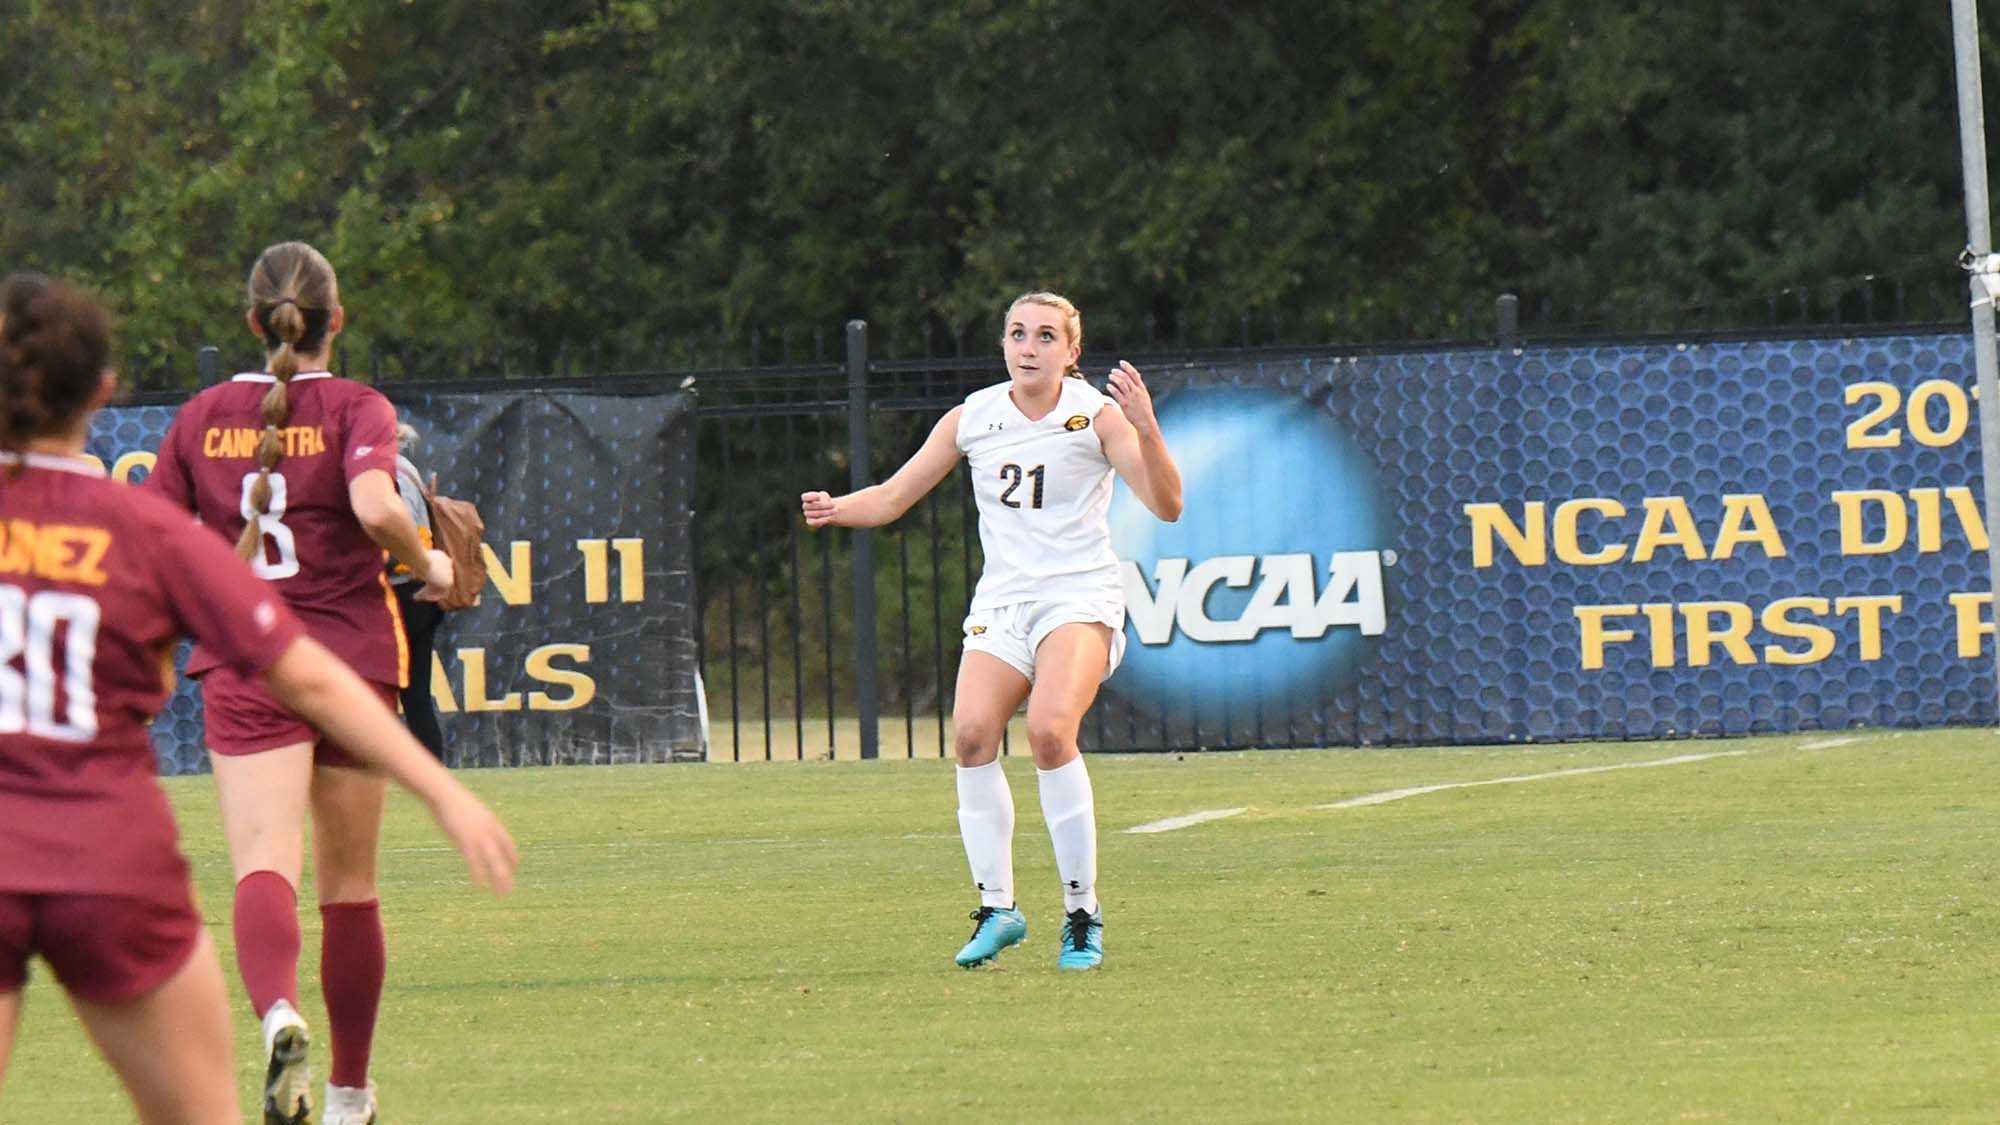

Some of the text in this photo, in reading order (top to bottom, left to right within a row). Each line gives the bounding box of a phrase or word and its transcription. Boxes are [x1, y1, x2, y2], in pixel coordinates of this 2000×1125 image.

[1844, 379, 1980, 449] 20
[1000, 464, 1045, 509] 21
[240, 472, 300, 580] 8
[1464, 494, 1786, 568] NCAA
[1118, 550, 1388, 645] NCAA
[1573, 595, 1902, 669] FIRST
